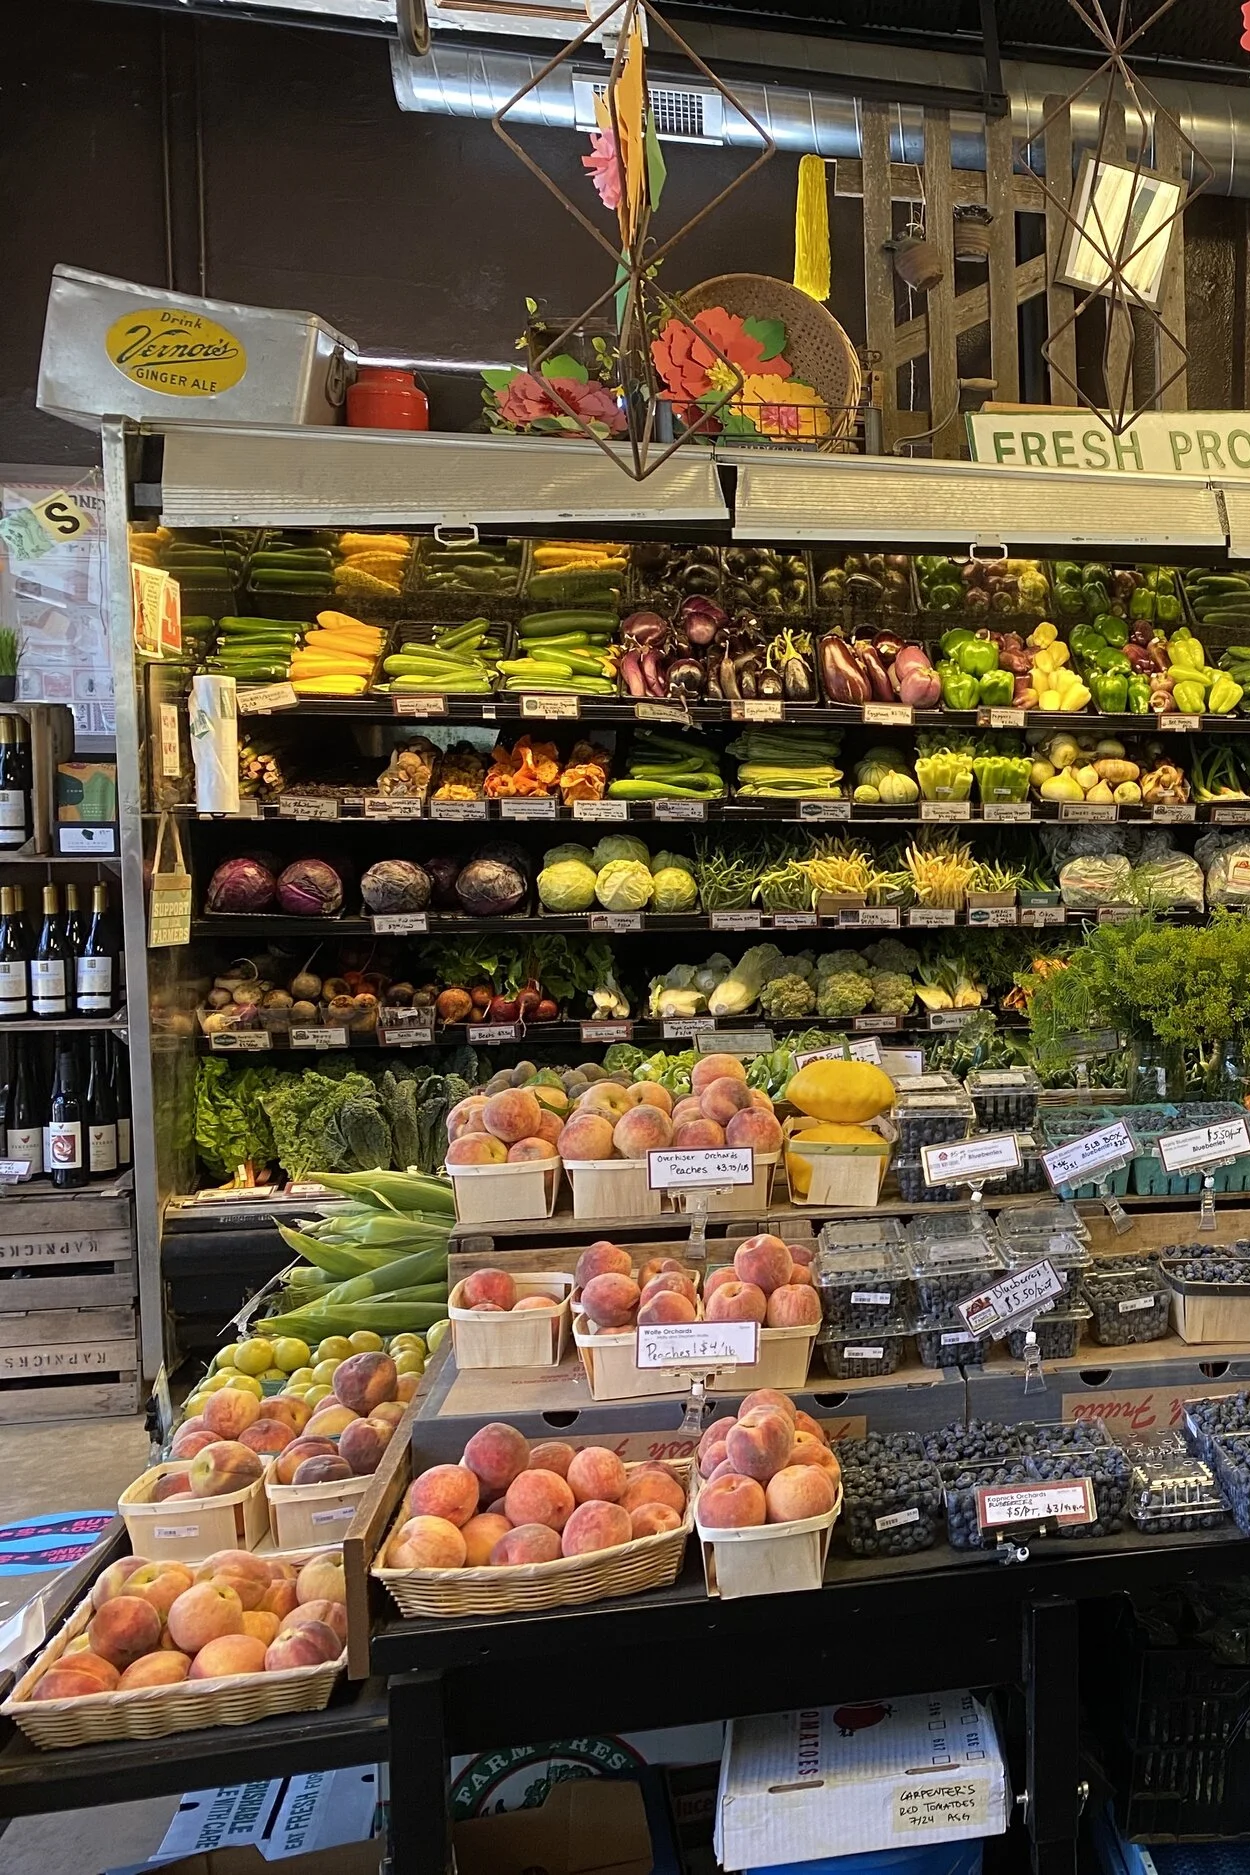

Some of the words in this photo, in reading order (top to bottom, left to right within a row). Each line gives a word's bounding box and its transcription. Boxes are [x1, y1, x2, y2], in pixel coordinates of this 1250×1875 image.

[159, 312, 203, 329] Drink
[116, 325, 239, 365] Vernor's
[136, 367, 187, 387] GINGER
[191, 379, 217, 393] ALE
[992, 429, 1144, 470] FRESH
[44, 502, 80, 534] S
[154, 901, 189, 917] SUPPORT
[153, 927, 189, 944] FARMERS
[1102, 1131, 1123, 1144] BOX
[1192, 1140, 1226, 1153] Blueberries
[704, 1151, 738, 1160] Orchards
[968, 1149, 1003, 1160] Blueberries
[1081, 1141, 1114, 1160] Blueberries
[669, 1163, 708, 1176] Peaches
[4, 1352, 106, 1369] KAPNICKS
[987, 1494, 1015, 1503] Kapnick
[798, 1711, 819, 1776] OMATOES
[455, 1743, 536, 1807] FARM
[899, 1784, 977, 1801] CARPENTER'S
[209, 1797, 235, 1820] WITH
[284, 1793, 319, 1832] FRESH
[899, 1805, 919, 1817] RED
[922, 1798, 976, 1813] TOMATOES
[194, 1819, 227, 1850] CARE
[284, 1830, 307, 1851] EAT
